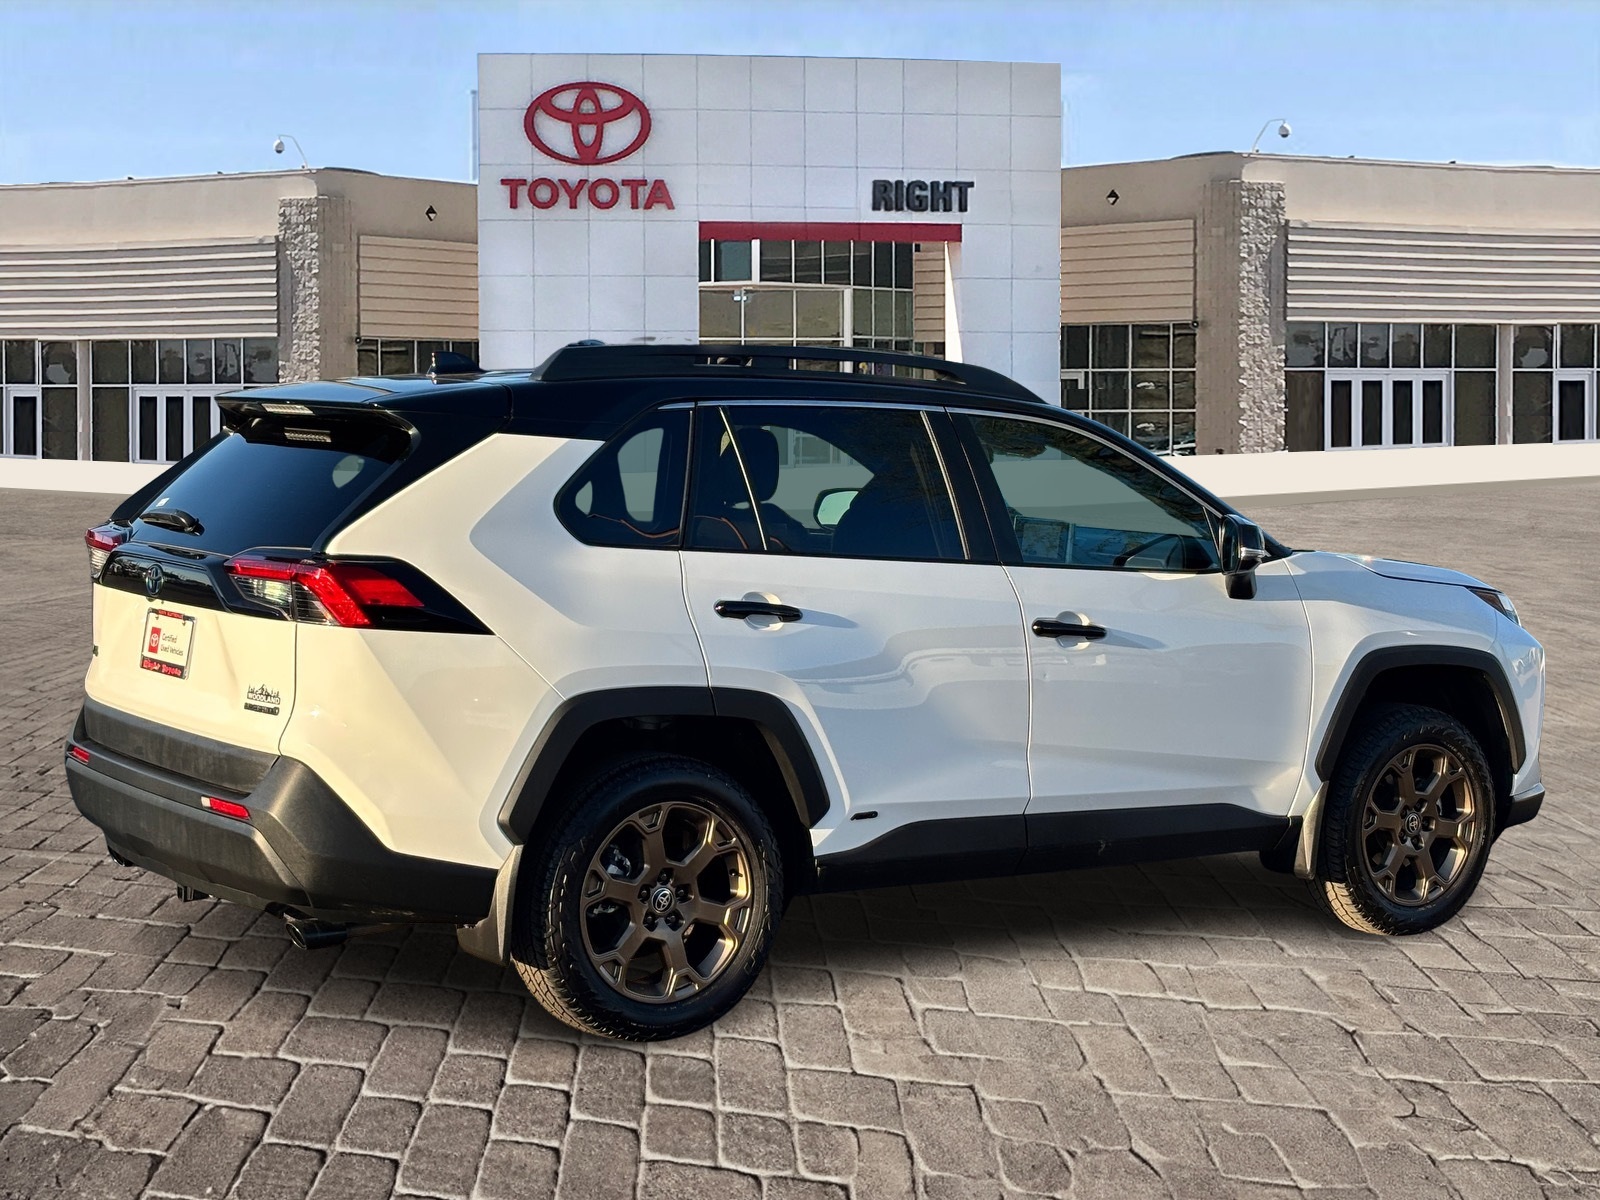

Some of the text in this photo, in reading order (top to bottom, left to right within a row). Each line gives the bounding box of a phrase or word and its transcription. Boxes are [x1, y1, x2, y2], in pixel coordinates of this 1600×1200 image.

[500, 178, 675, 210] TOYOTA
[872, 180, 975, 212] RIGHT
[162, 633, 178, 644] Certified
[170, 646, 184, 656] Vehicles
[248, 692, 280, 704] WOODLAND
